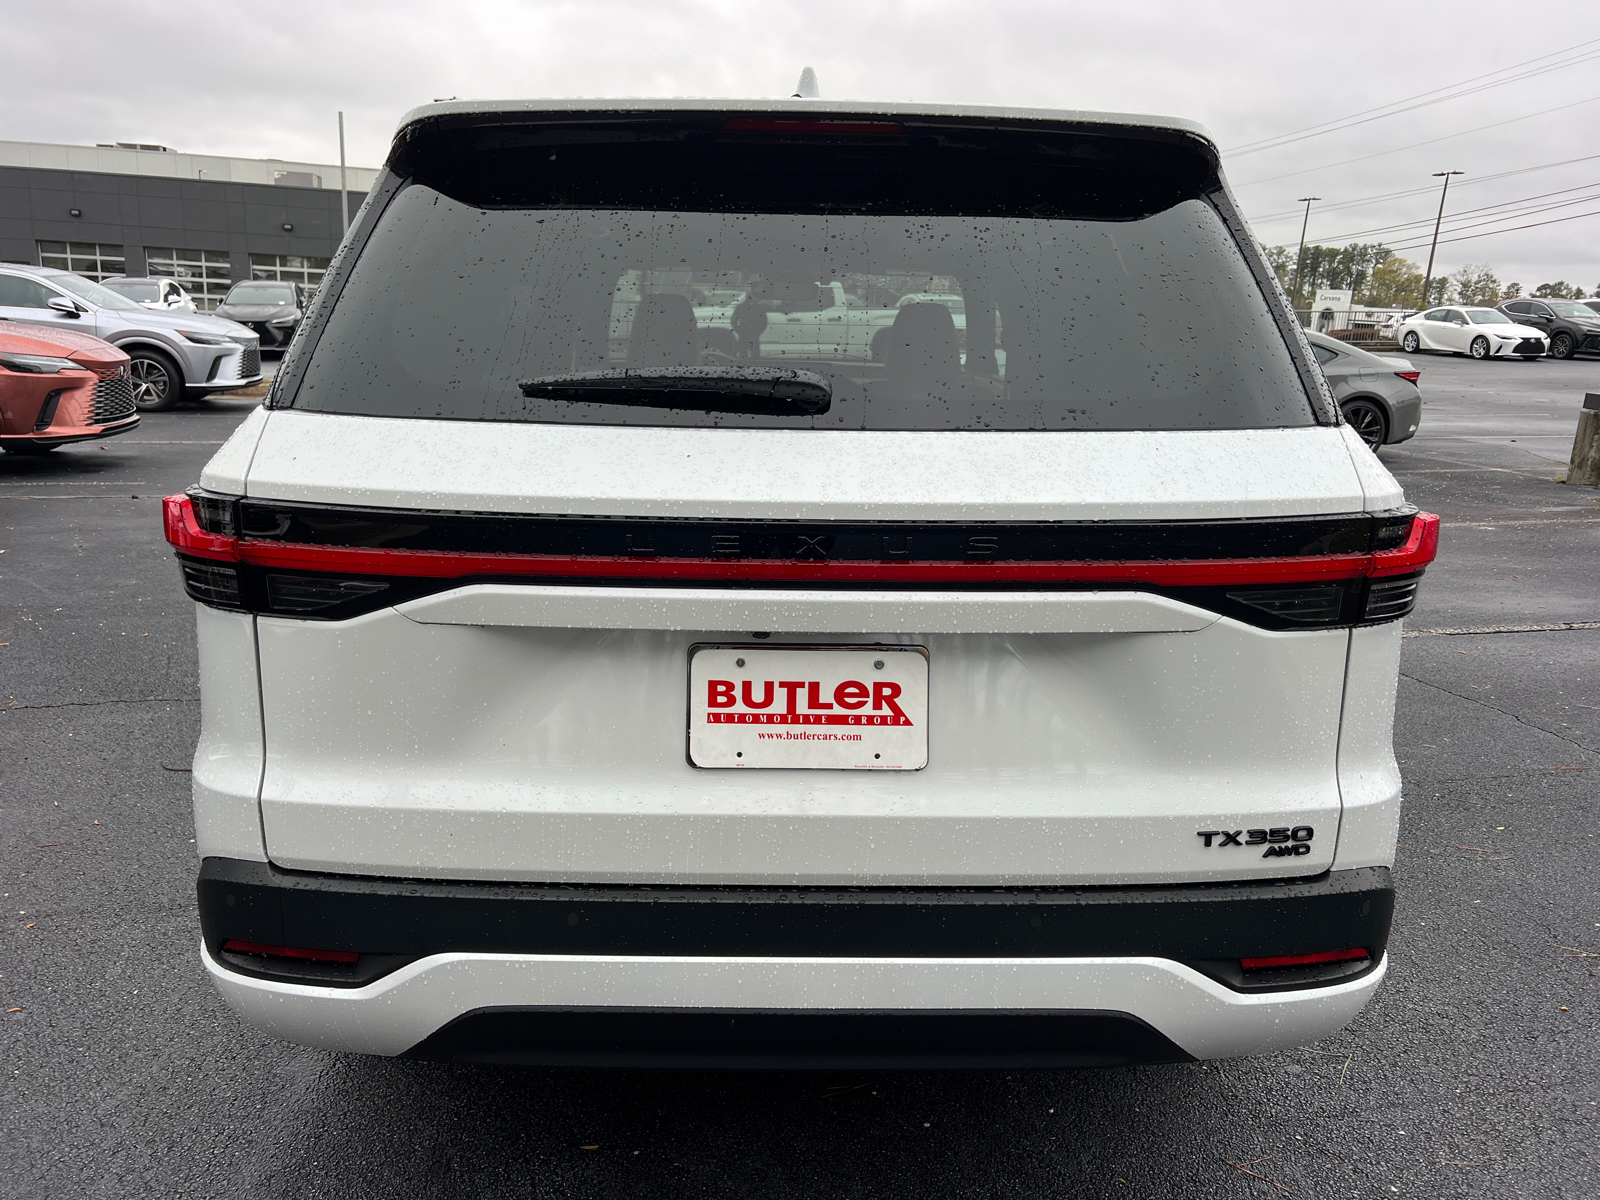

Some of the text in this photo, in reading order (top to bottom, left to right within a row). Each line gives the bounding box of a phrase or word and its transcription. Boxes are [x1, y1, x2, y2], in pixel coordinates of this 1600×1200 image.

[1320, 294, 1341, 302] Carvana
[624, 533, 1000, 555] LEXUS
[707, 714, 907, 725] AUTOMOTIVE GROUP
[758, 731, 862, 742] www.butlercars.com
[1261, 842, 1312, 859] AWD
